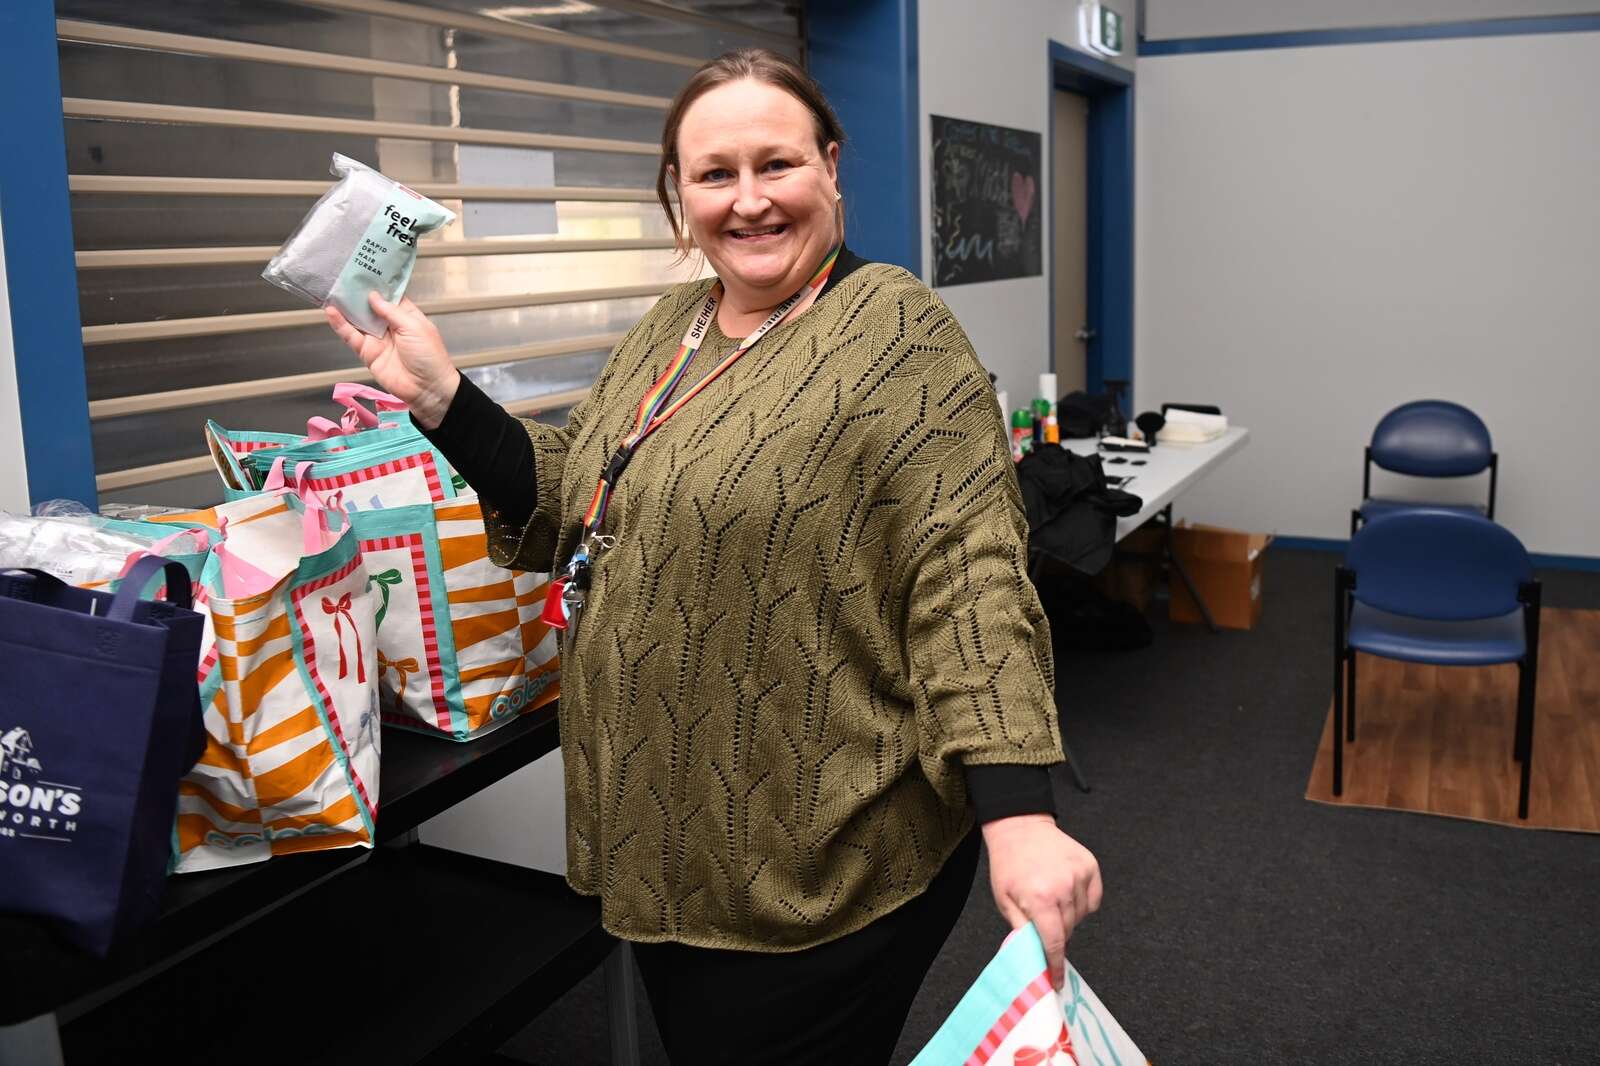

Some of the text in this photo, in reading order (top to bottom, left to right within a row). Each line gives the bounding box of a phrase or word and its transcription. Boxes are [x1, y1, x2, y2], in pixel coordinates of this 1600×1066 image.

[384, 204, 417, 231] feel
[386, 222, 416, 249] fres
[361, 244, 377, 256] DRY
[366, 238, 387, 254] RAPID
[354, 257, 383, 276] TURBAN
[358, 251, 376, 265] HAIR
[690, 296, 717, 339] SHE/HER
